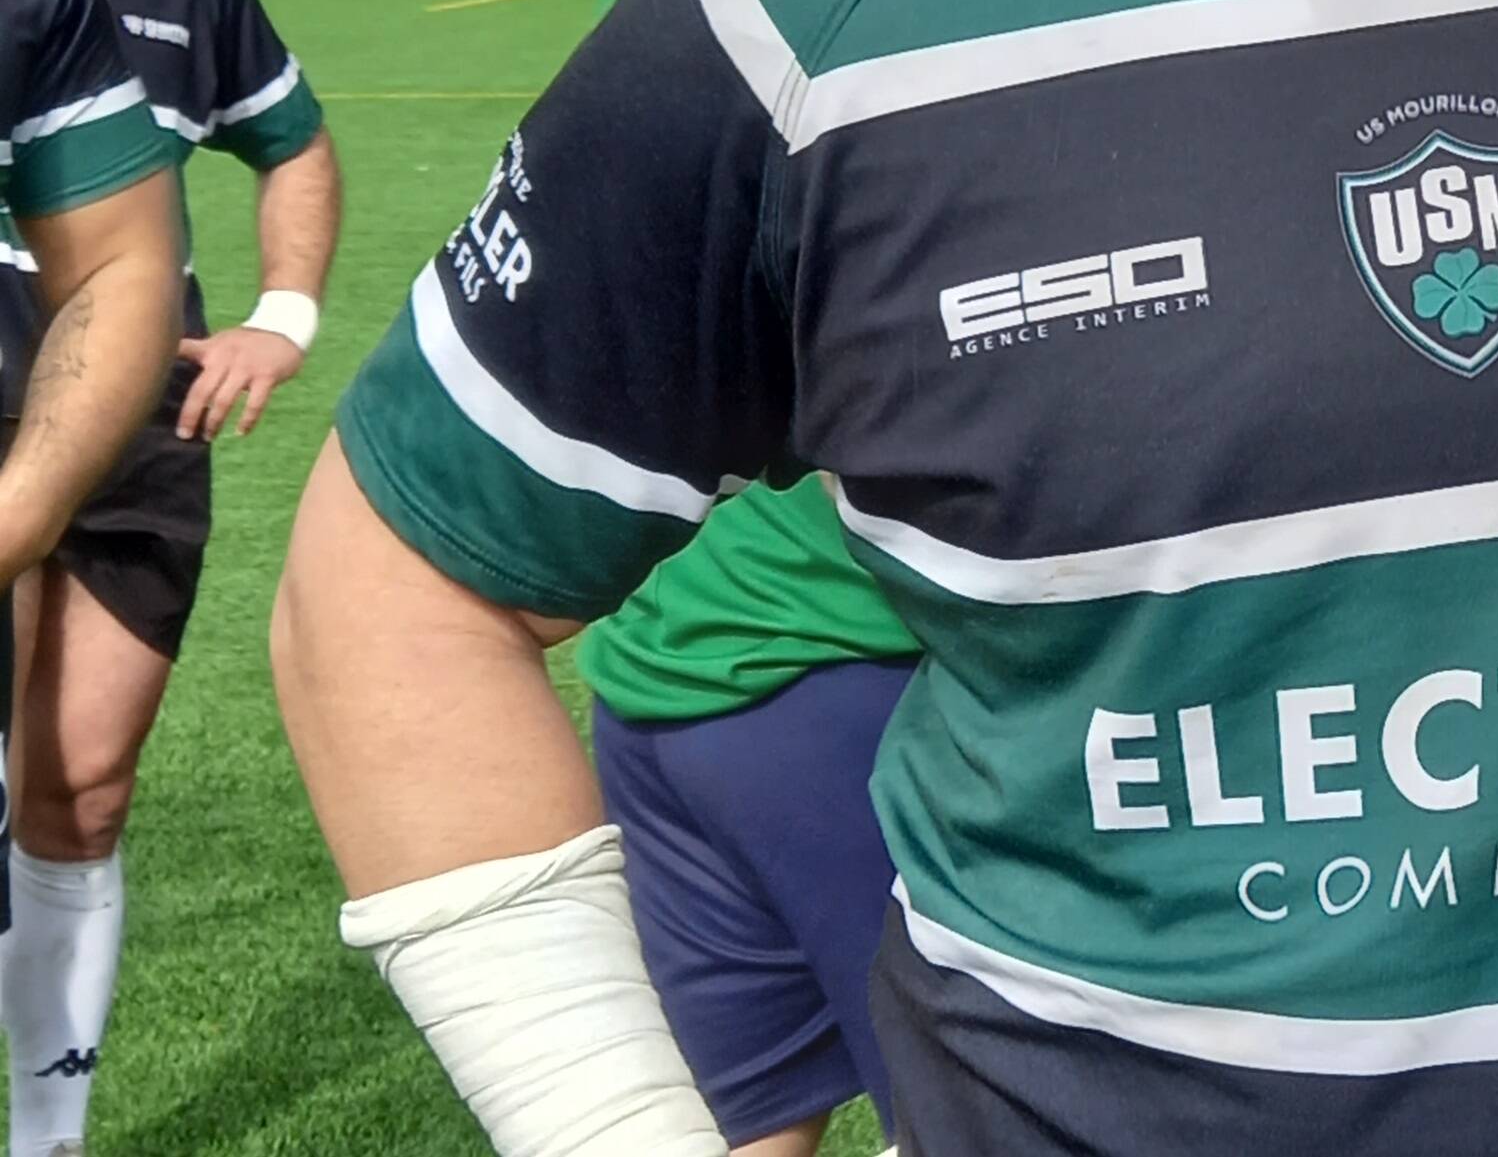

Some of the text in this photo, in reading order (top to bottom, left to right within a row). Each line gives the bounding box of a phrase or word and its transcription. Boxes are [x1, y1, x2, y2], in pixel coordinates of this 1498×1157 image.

[1356, 117, 1386, 144] US
[940, 236, 1207, 342] ESO
[950, 293, 1211, 359] AGENCE INTERIM
